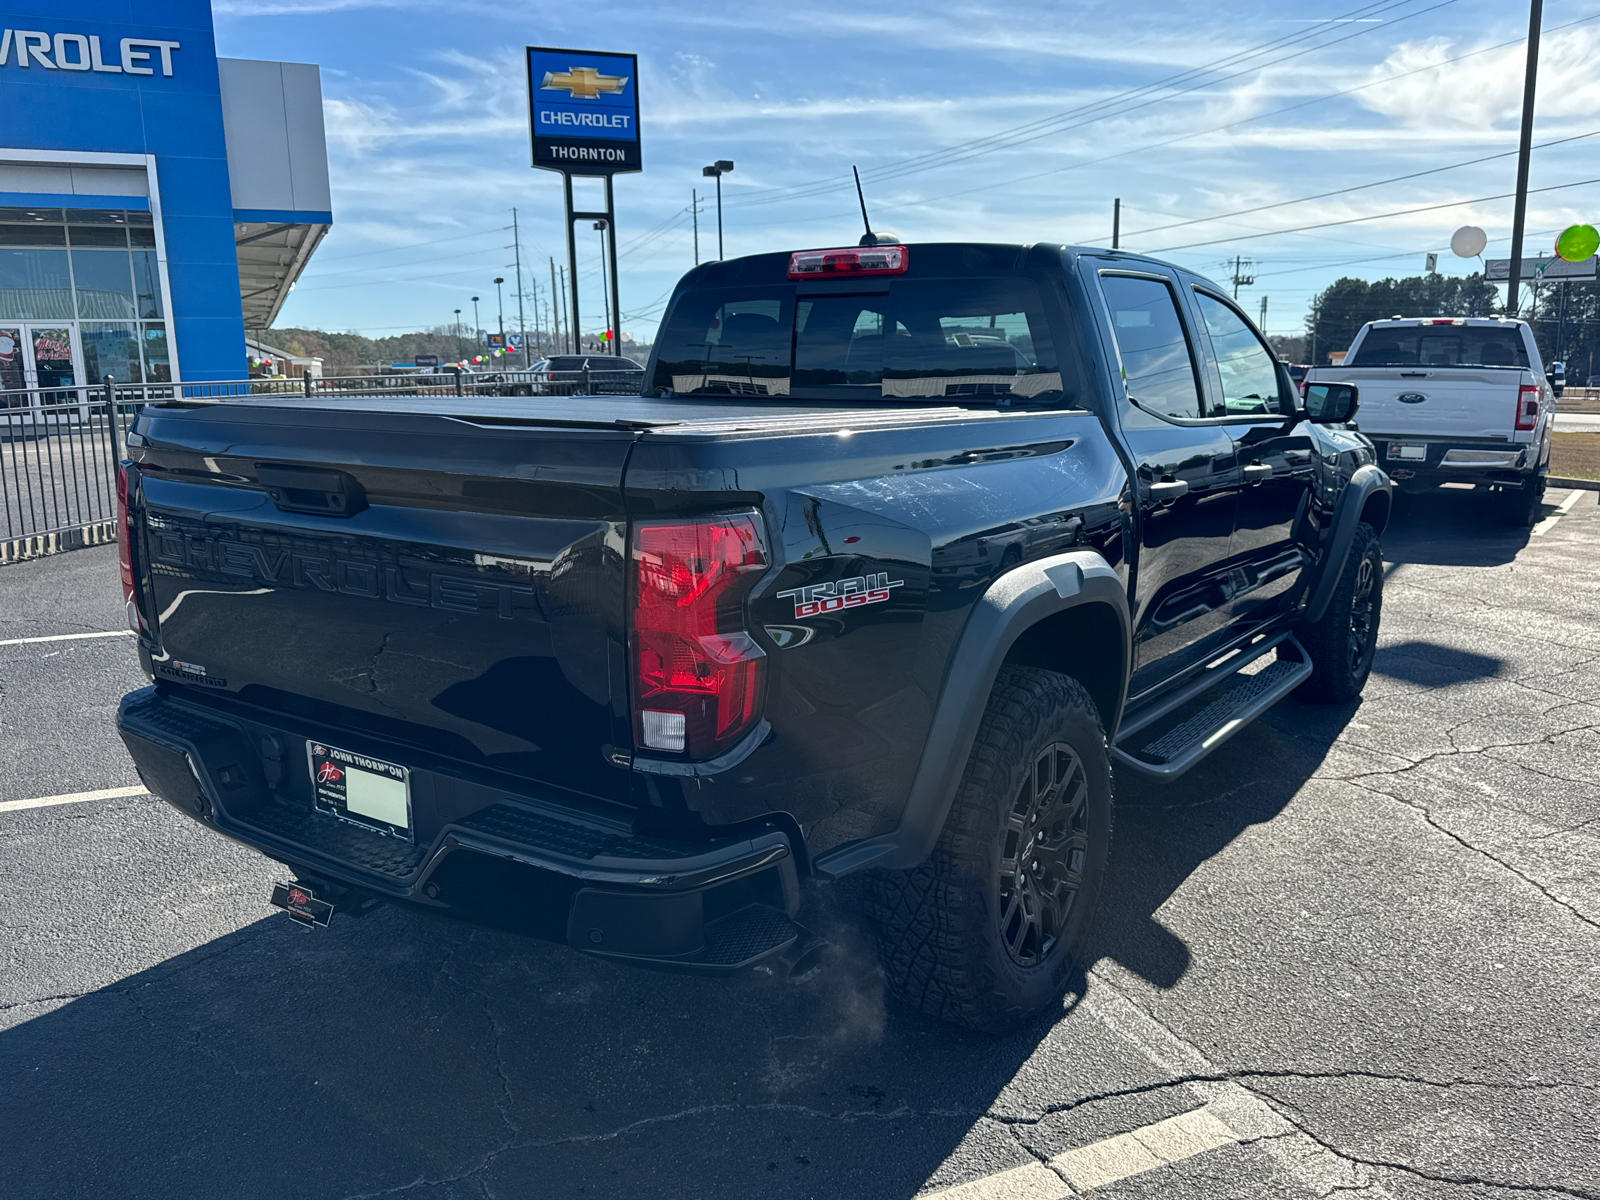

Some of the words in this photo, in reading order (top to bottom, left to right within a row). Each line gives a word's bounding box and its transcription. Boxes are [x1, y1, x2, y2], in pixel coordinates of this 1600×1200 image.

[541, 111, 630, 128] CHEVROLET
[550, 146, 626, 161] THORNTON
[153, 528, 534, 620] CHEVROLET
[777, 572, 904, 605] TRAIL
[795, 588, 889, 619] BOSS
[330, 749, 353, 764] JOHN
[353, 756, 403, 778] THORNTON
